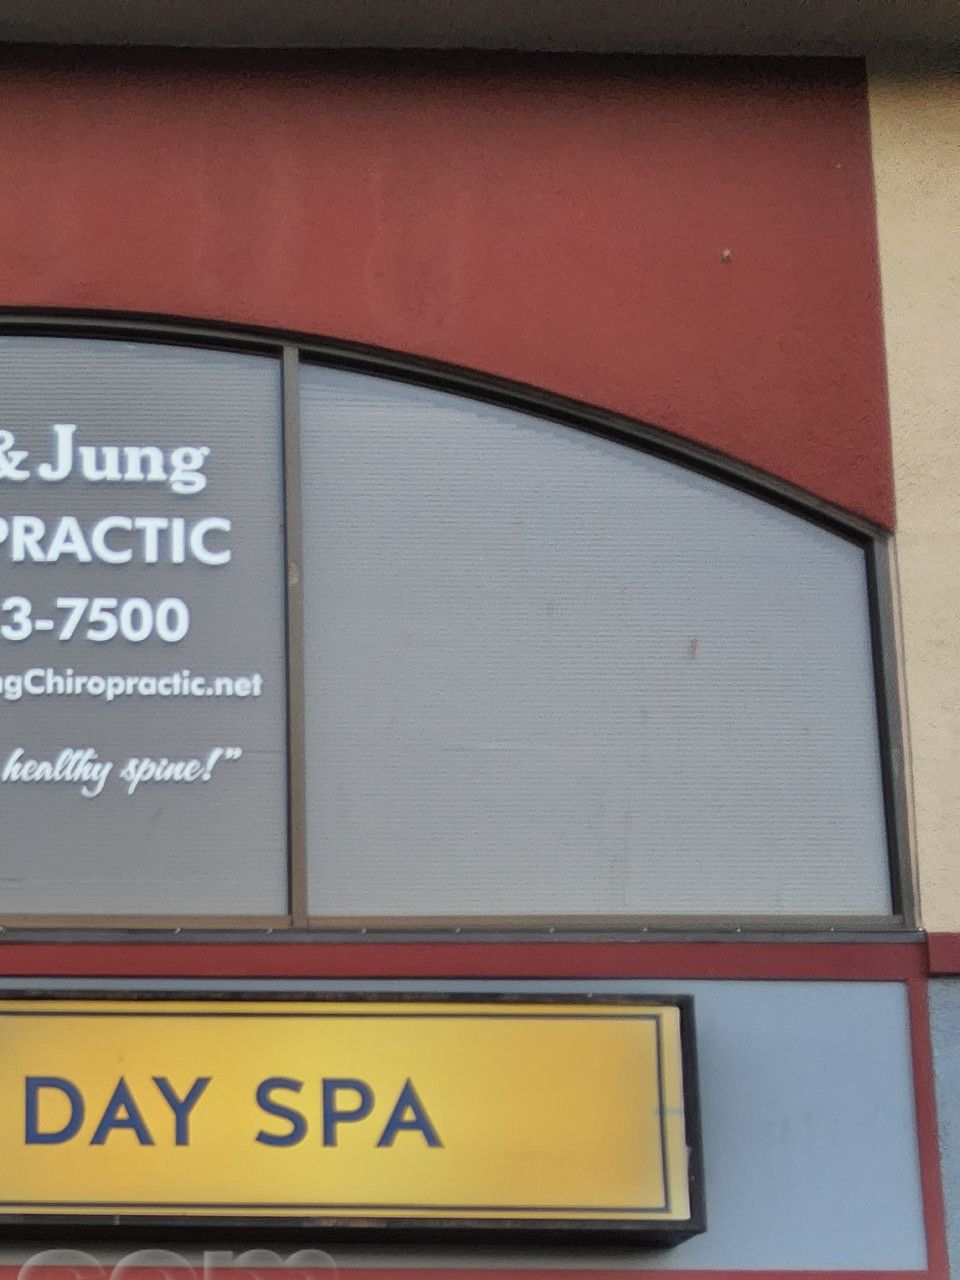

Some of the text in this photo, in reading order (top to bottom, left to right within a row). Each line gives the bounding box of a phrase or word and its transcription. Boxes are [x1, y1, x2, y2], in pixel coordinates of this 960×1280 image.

[38, 424, 210, 494] Jung
[1, 747, 113, 798] healthy
[23, 1075, 213, 1147] DAY
[254, 1076, 445, 1149] SPA
